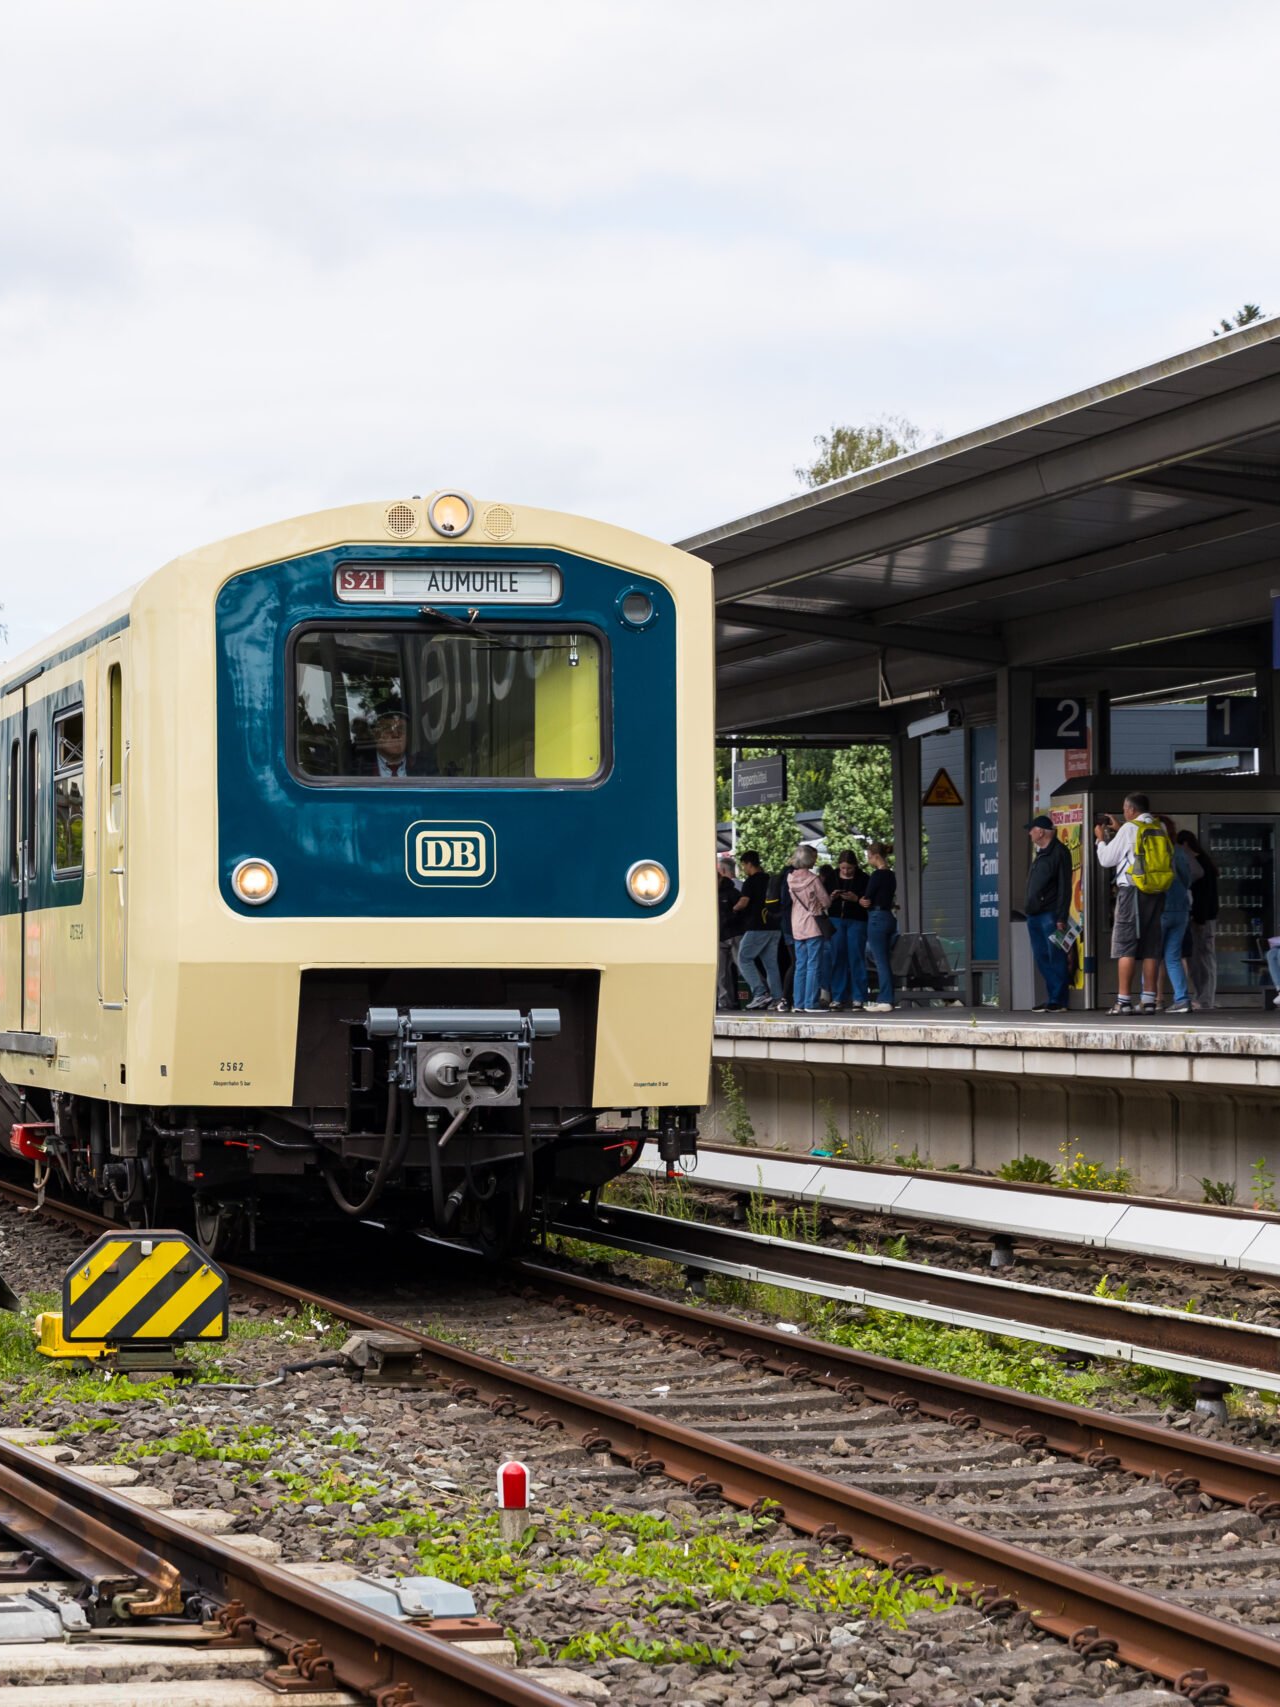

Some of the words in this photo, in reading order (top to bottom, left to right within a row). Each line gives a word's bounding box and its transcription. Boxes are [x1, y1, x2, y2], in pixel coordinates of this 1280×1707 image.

[344, 571, 355, 588] S
[359, 571, 377, 588] 21
[1057, 699, 1079, 736] 2
[1215, 699, 1230, 736] 1
[424, 840, 477, 868] DB
[220, 1062, 243, 1071] 2562
